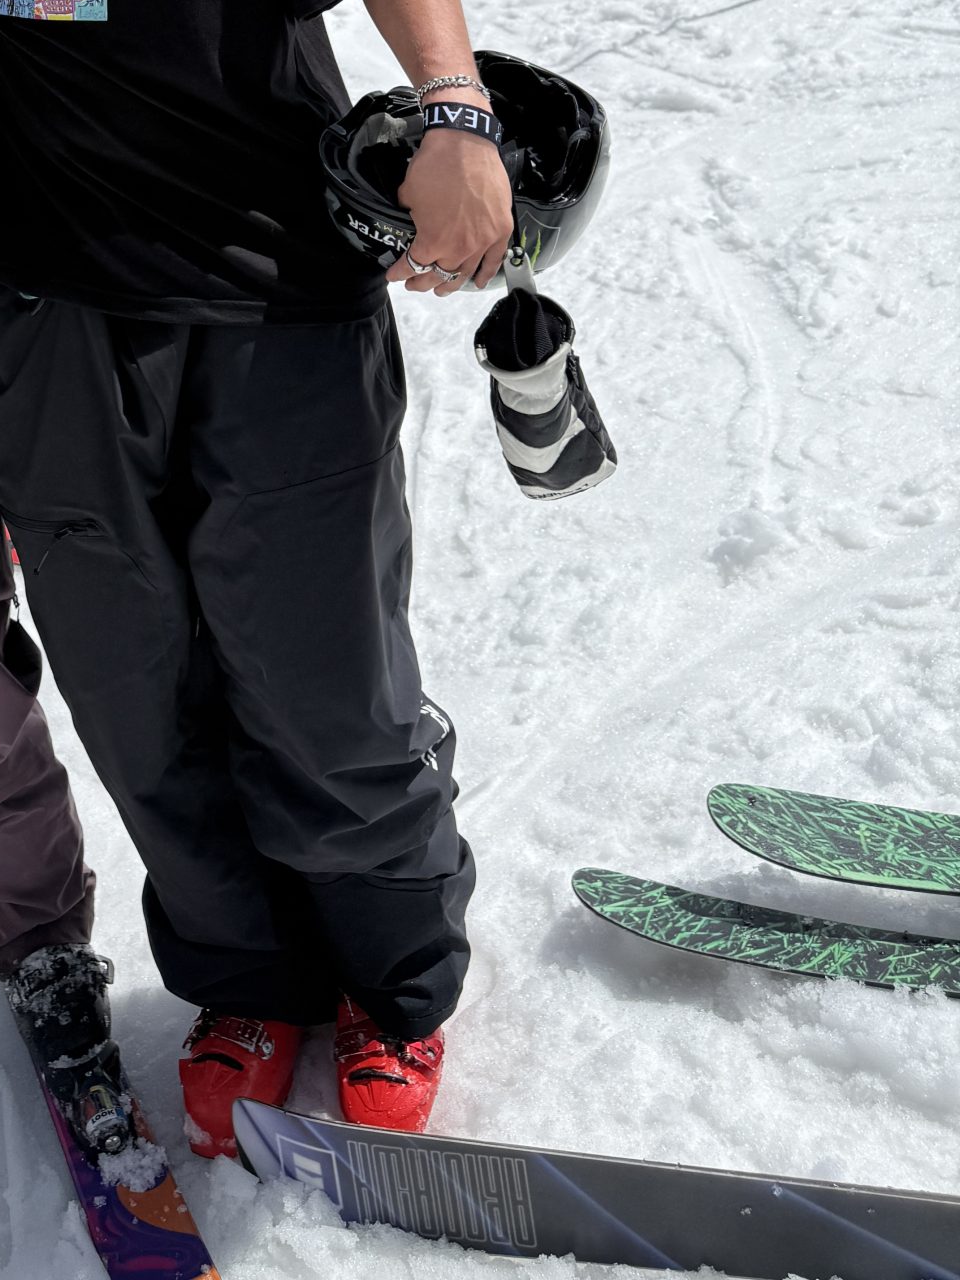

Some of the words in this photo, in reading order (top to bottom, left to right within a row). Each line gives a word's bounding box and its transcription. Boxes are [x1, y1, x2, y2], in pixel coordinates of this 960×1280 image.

[346, 213, 410, 252] NSTER
[373, 221, 416, 239] ARMY
[91, 1109, 115, 1125] LOOK
